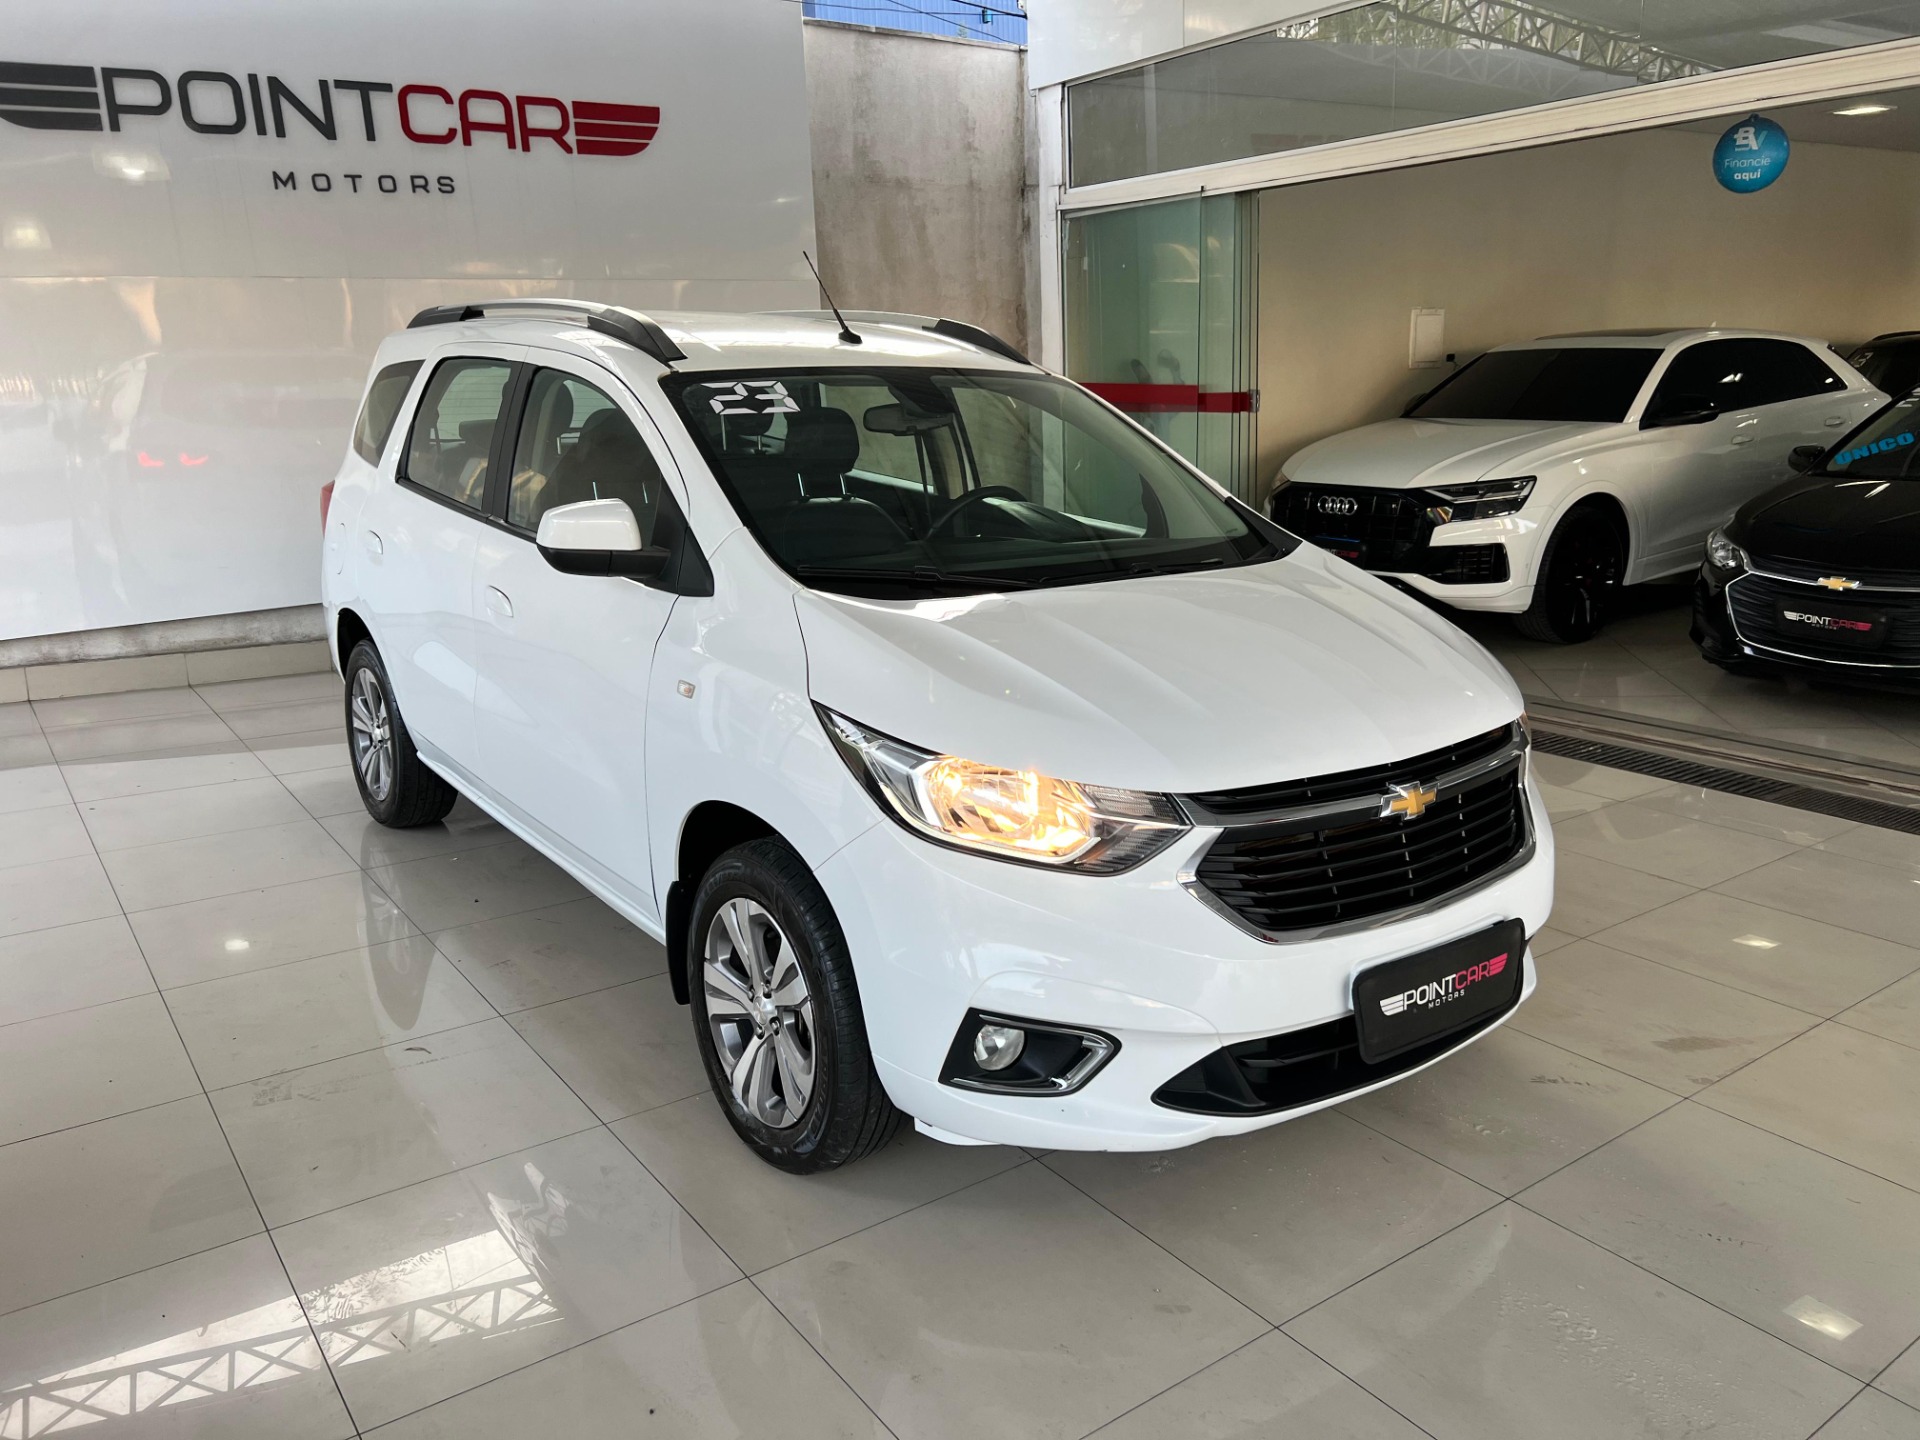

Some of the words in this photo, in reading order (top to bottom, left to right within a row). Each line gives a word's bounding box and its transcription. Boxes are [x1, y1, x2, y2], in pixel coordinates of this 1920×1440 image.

[100, 67, 573, 154] POINTCAR
[1724, 156, 1771, 168] Financie
[272, 170, 456, 194] MOTORS
[1734, 169, 1761, 181] aqui
[700, 380, 801, 414] 23
[1834, 432, 1915, 465] UNICO
[1796, 612, 1857, 630] POINTCAR
[1404, 961, 1491, 1010] POINTCAR
[1428, 989, 1465, 1009] MOTORS
